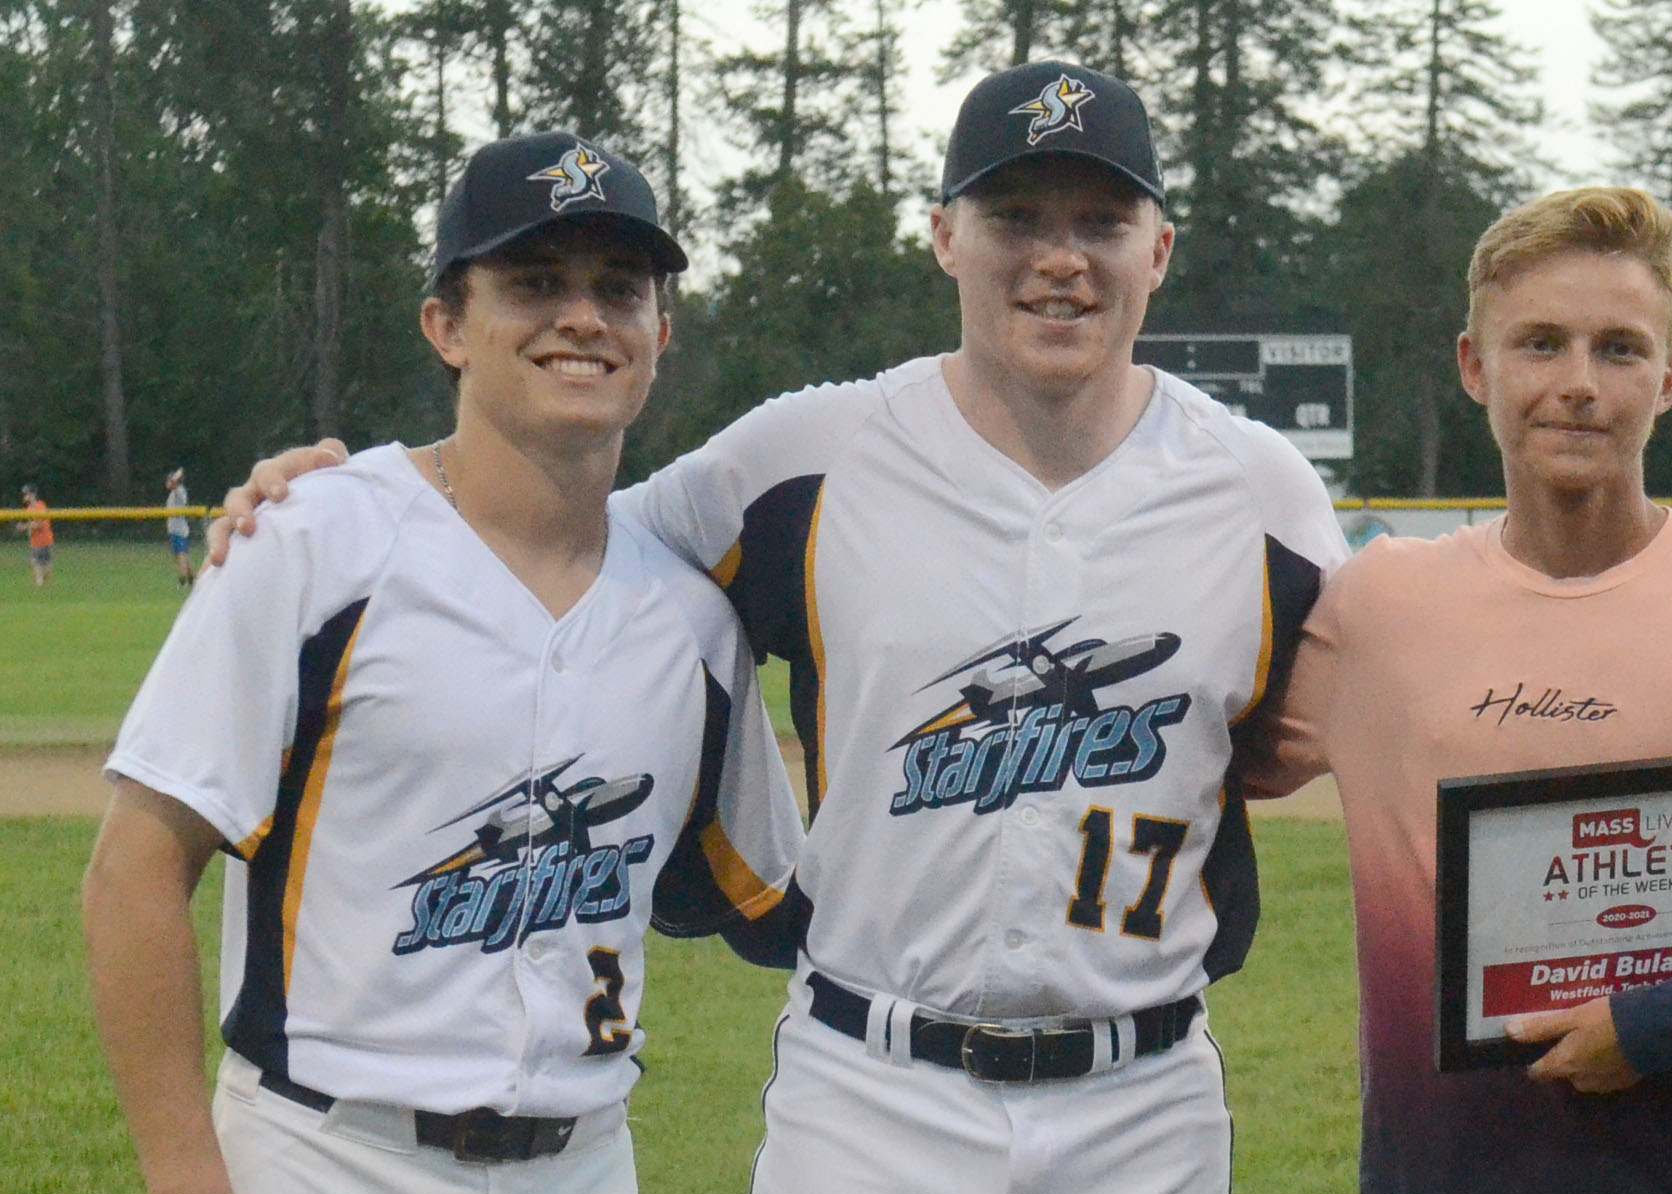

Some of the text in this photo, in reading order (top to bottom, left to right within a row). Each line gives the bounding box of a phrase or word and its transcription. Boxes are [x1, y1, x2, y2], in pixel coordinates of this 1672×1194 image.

[1265, 342, 1345, 361] VISITOR
[1470, 682, 1617, 727] Hollister
[889, 692, 1192, 817] Starfires
[1579, 817, 1635, 838] MASS
[1066, 804, 1190, 942] 17
[1578, 886, 1599, 899] OF
[1603, 882, 1631, 897] THE
[391, 832, 655, 957] Starfires
[1602, 910, 1651, 923] 2020-2021
[1530, 957, 1608, 986] David
[578, 944, 633, 1058] 2
